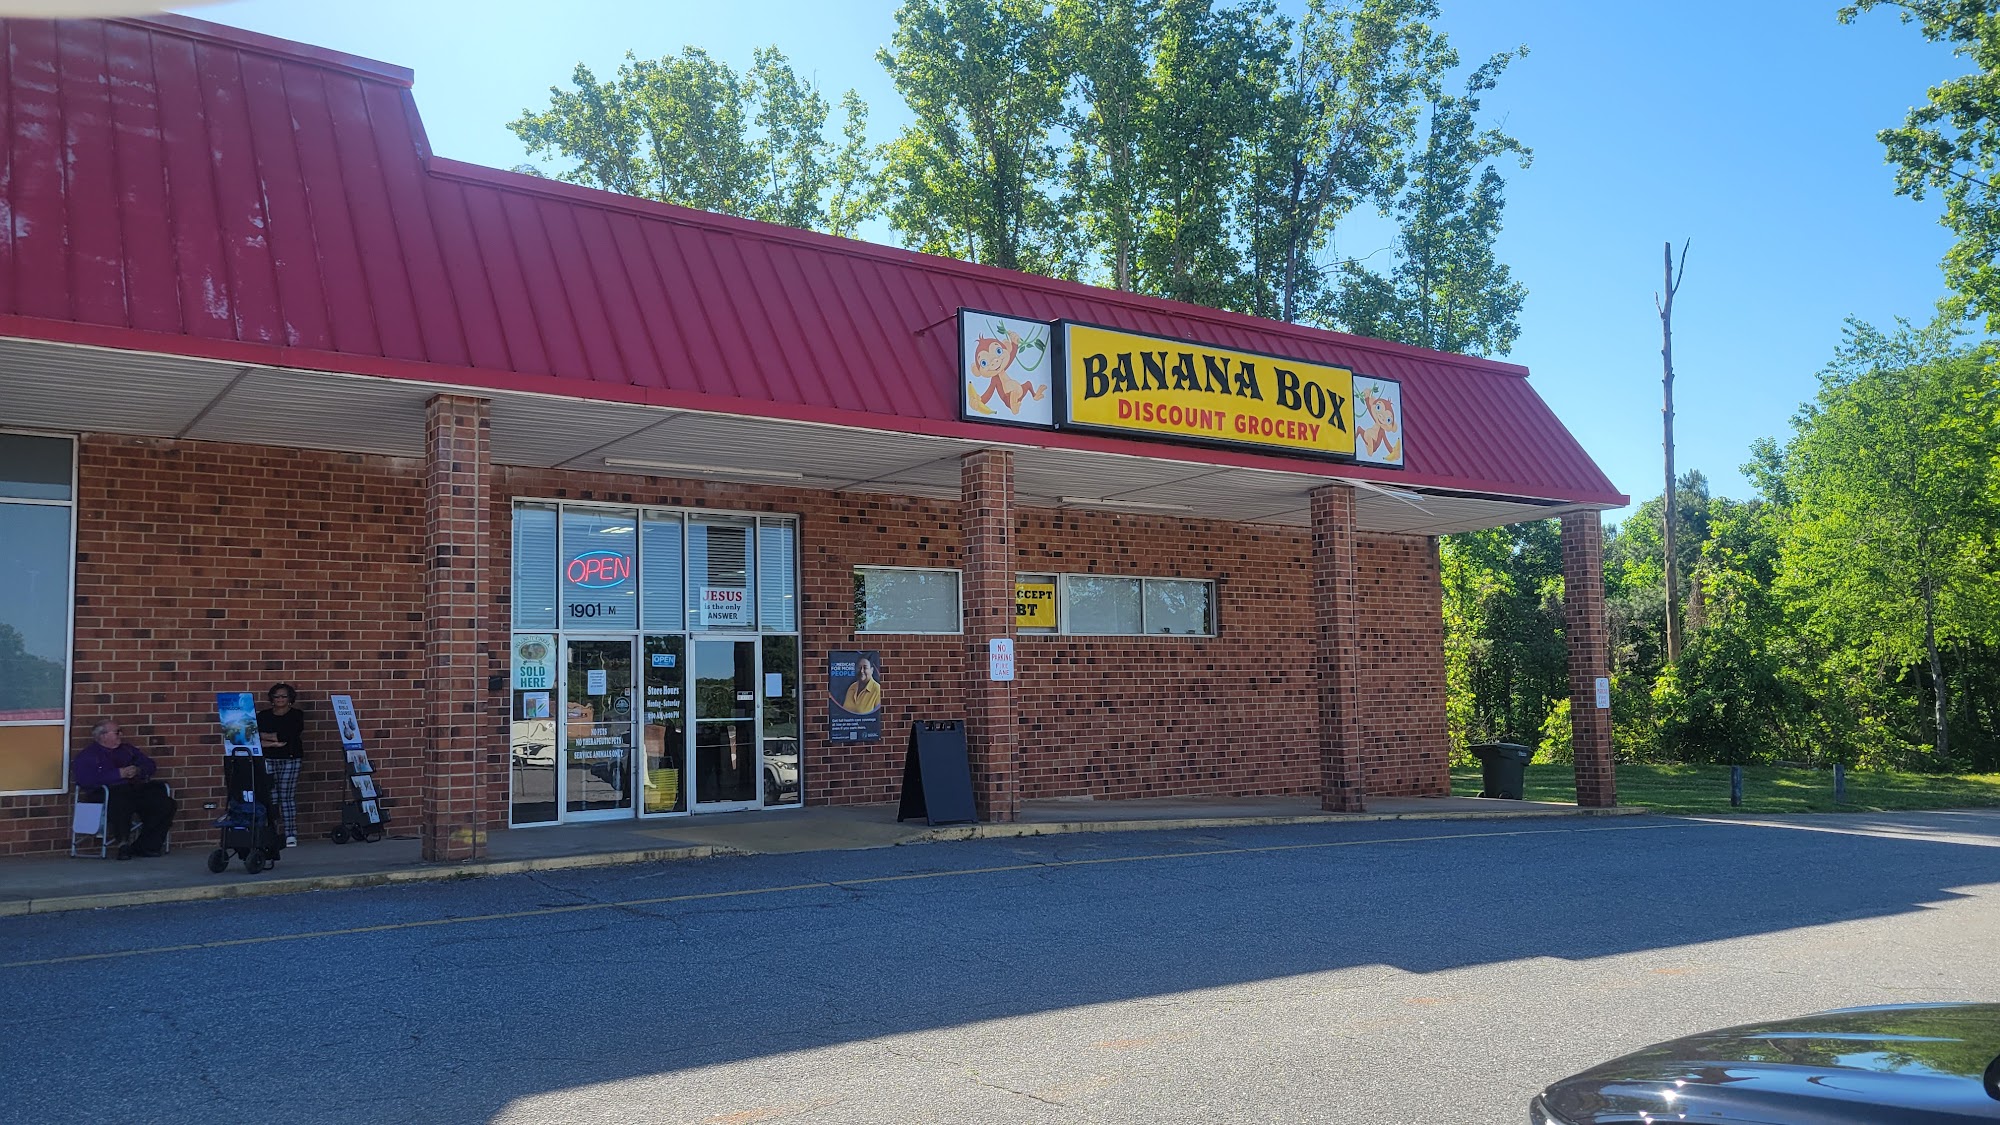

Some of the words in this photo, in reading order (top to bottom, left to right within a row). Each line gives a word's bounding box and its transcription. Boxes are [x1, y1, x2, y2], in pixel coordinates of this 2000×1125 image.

[1083, 351, 1264, 401] BANANA
[1273, 366, 1347, 434] BOX
[1118, 398, 1226, 431] DISCOUNT
[1234, 413, 1321, 443] GROCERY
[568, 556, 630, 582] OPEN
[703, 590, 742, 601] JESUS
[1015, 590, 1053, 600] CCEPT
[568, 603, 601, 617] 1901
[707, 612, 738, 620] ANSWER
[997, 644, 1006, 652] NO
[992, 653, 1012, 662] PARKING
[520, 666, 546, 677] SOLD
[521, 677, 546, 688] HERE
[647, 685, 662, 695] Store
[663, 685, 680, 695] Hours
[591, 728, 597, 736] NO
[575, 738, 582, 746] NO
[583, 737, 611, 745] THERAPEUTIC
[574, 751, 592, 759] SERVICE
[593, 750, 611, 758] ANIMALS
